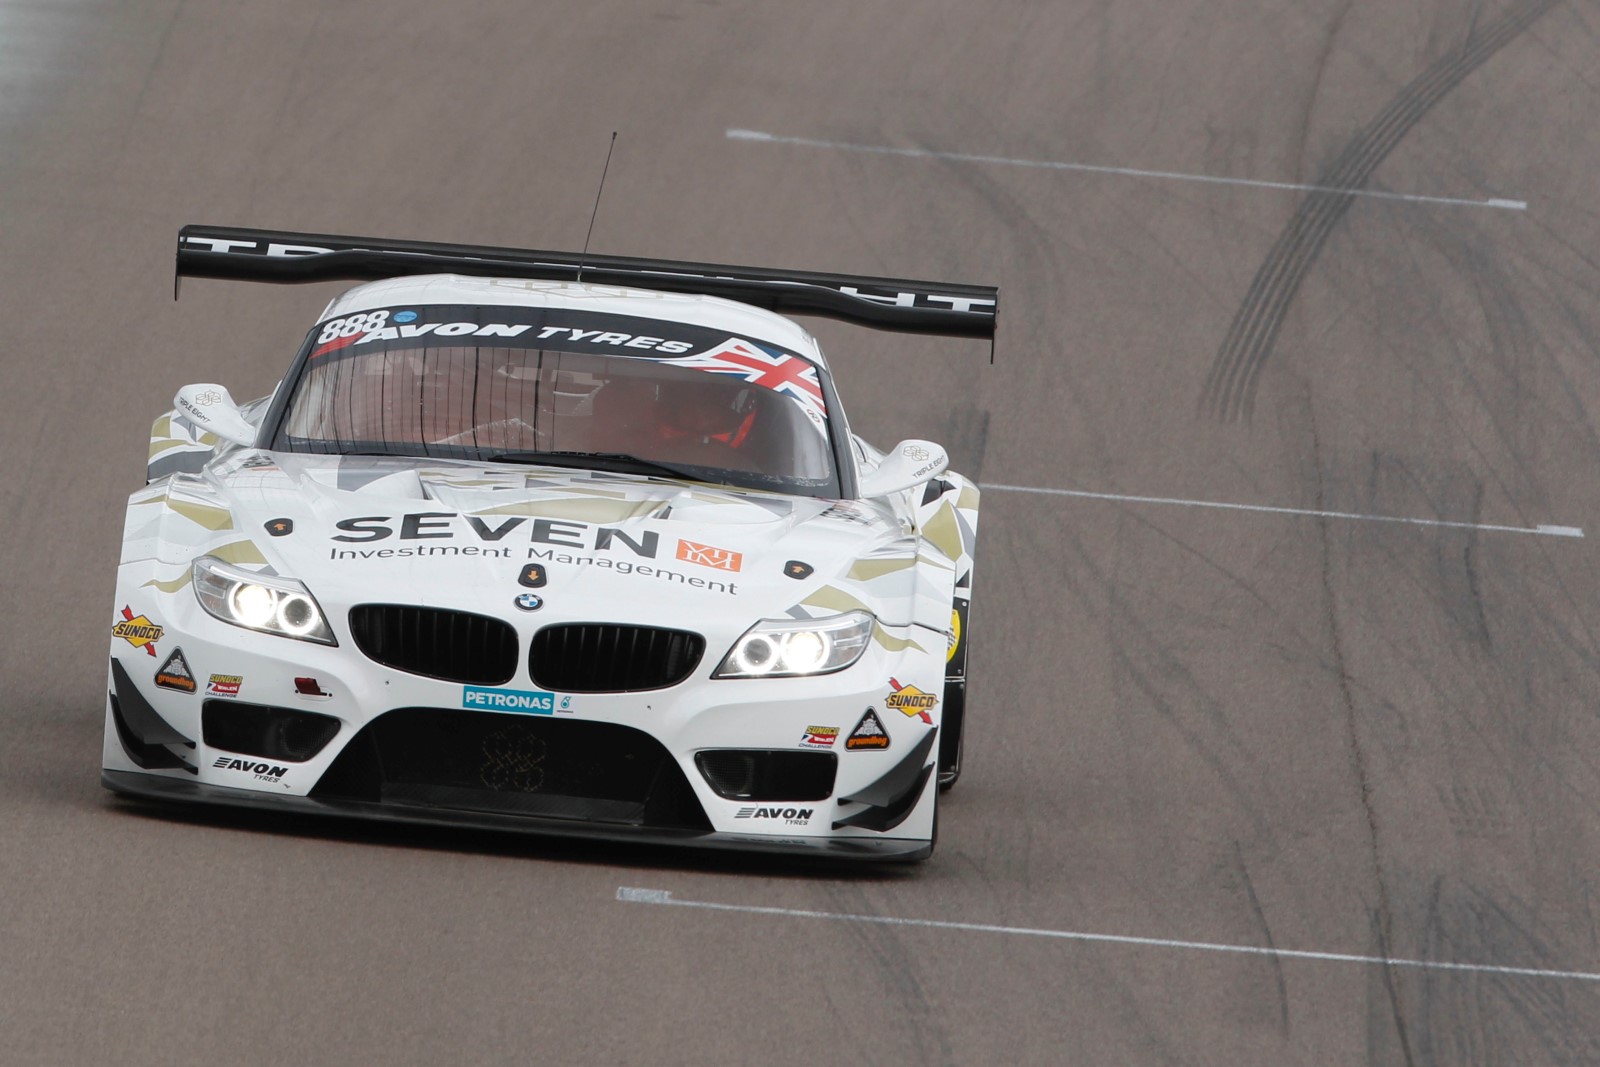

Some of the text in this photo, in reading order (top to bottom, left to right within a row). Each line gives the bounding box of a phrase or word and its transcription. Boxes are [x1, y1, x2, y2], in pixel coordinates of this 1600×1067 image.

[318, 310, 390, 344] 888
[353, 322, 694, 353] AVON TYRES
[192, 407, 211, 423] EIGHT
[330, 512, 659, 559] SEVEN
[331, 545, 738, 595] Investment Management
[116, 624, 161, 639] SUNOCO
[157, 674, 194, 690] groundhog
[209, 674, 243, 685] SUNOCO
[466, 691, 552, 710] PETRONAS
[889, 695, 934, 708] SUNOCO
[805, 725, 840, 735] SUNOCO
[230, 759, 289, 778] AVON
[253, 774, 280, 783] TYRES
[754, 807, 814, 819] AVON
